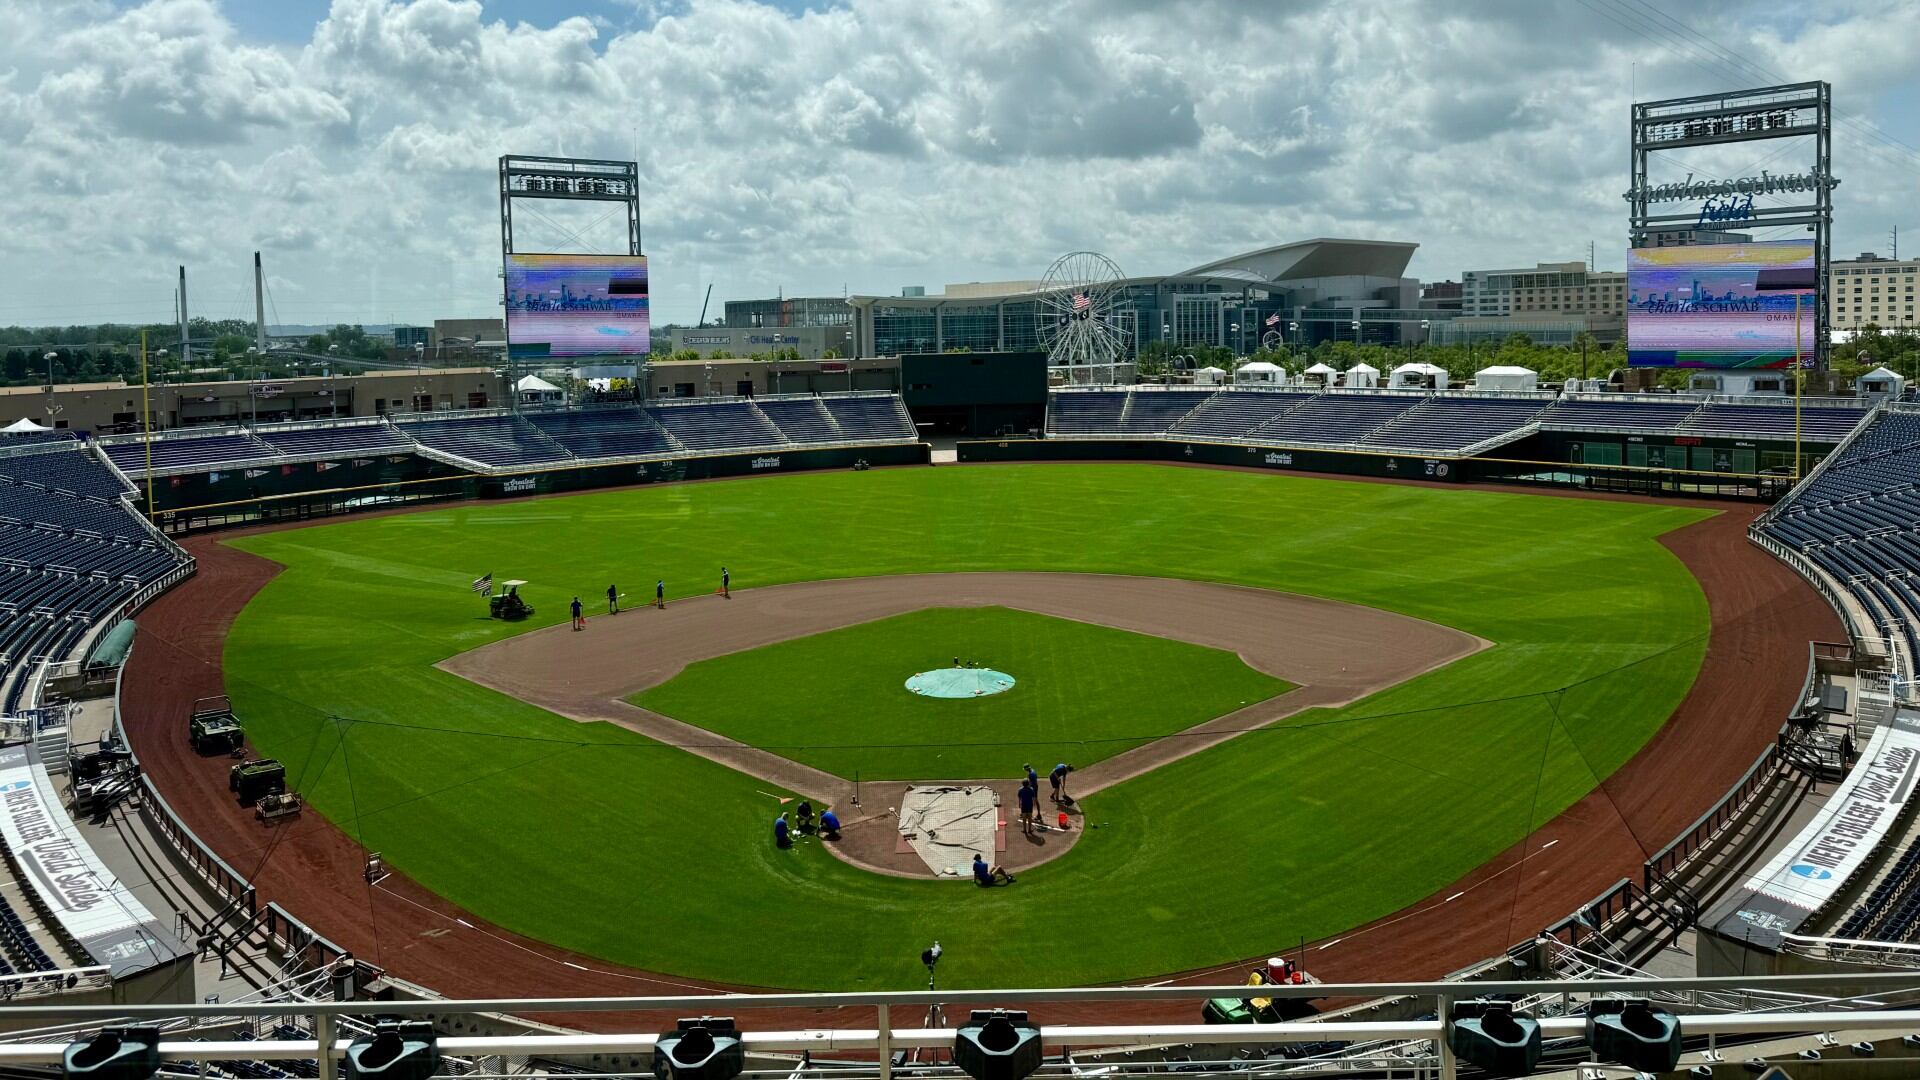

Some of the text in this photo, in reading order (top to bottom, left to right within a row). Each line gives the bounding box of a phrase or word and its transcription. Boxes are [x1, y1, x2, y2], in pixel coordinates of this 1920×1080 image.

[1693, 195, 1754, 229] field
[568, 302, 612, 312] SCHWAB
[1648, 299, 1760, 314] charles SCHWAB
[1674, 437, 1702, 446] ESPN
[163, 511, 176, 519] 335
[1871, 746, 1916, 774] Series
[4, 788, 39, 813] MEN'S
[1849, 770, 1899, 803] World
[11, 809, 56, 844] COLLEGE
[1830, 801, 1886, 840] COLLEGE
[33, 838, 86, 874] World
[1801, 835, 1858, 869] MEN'S
[54, 870, 103, 910] Series
